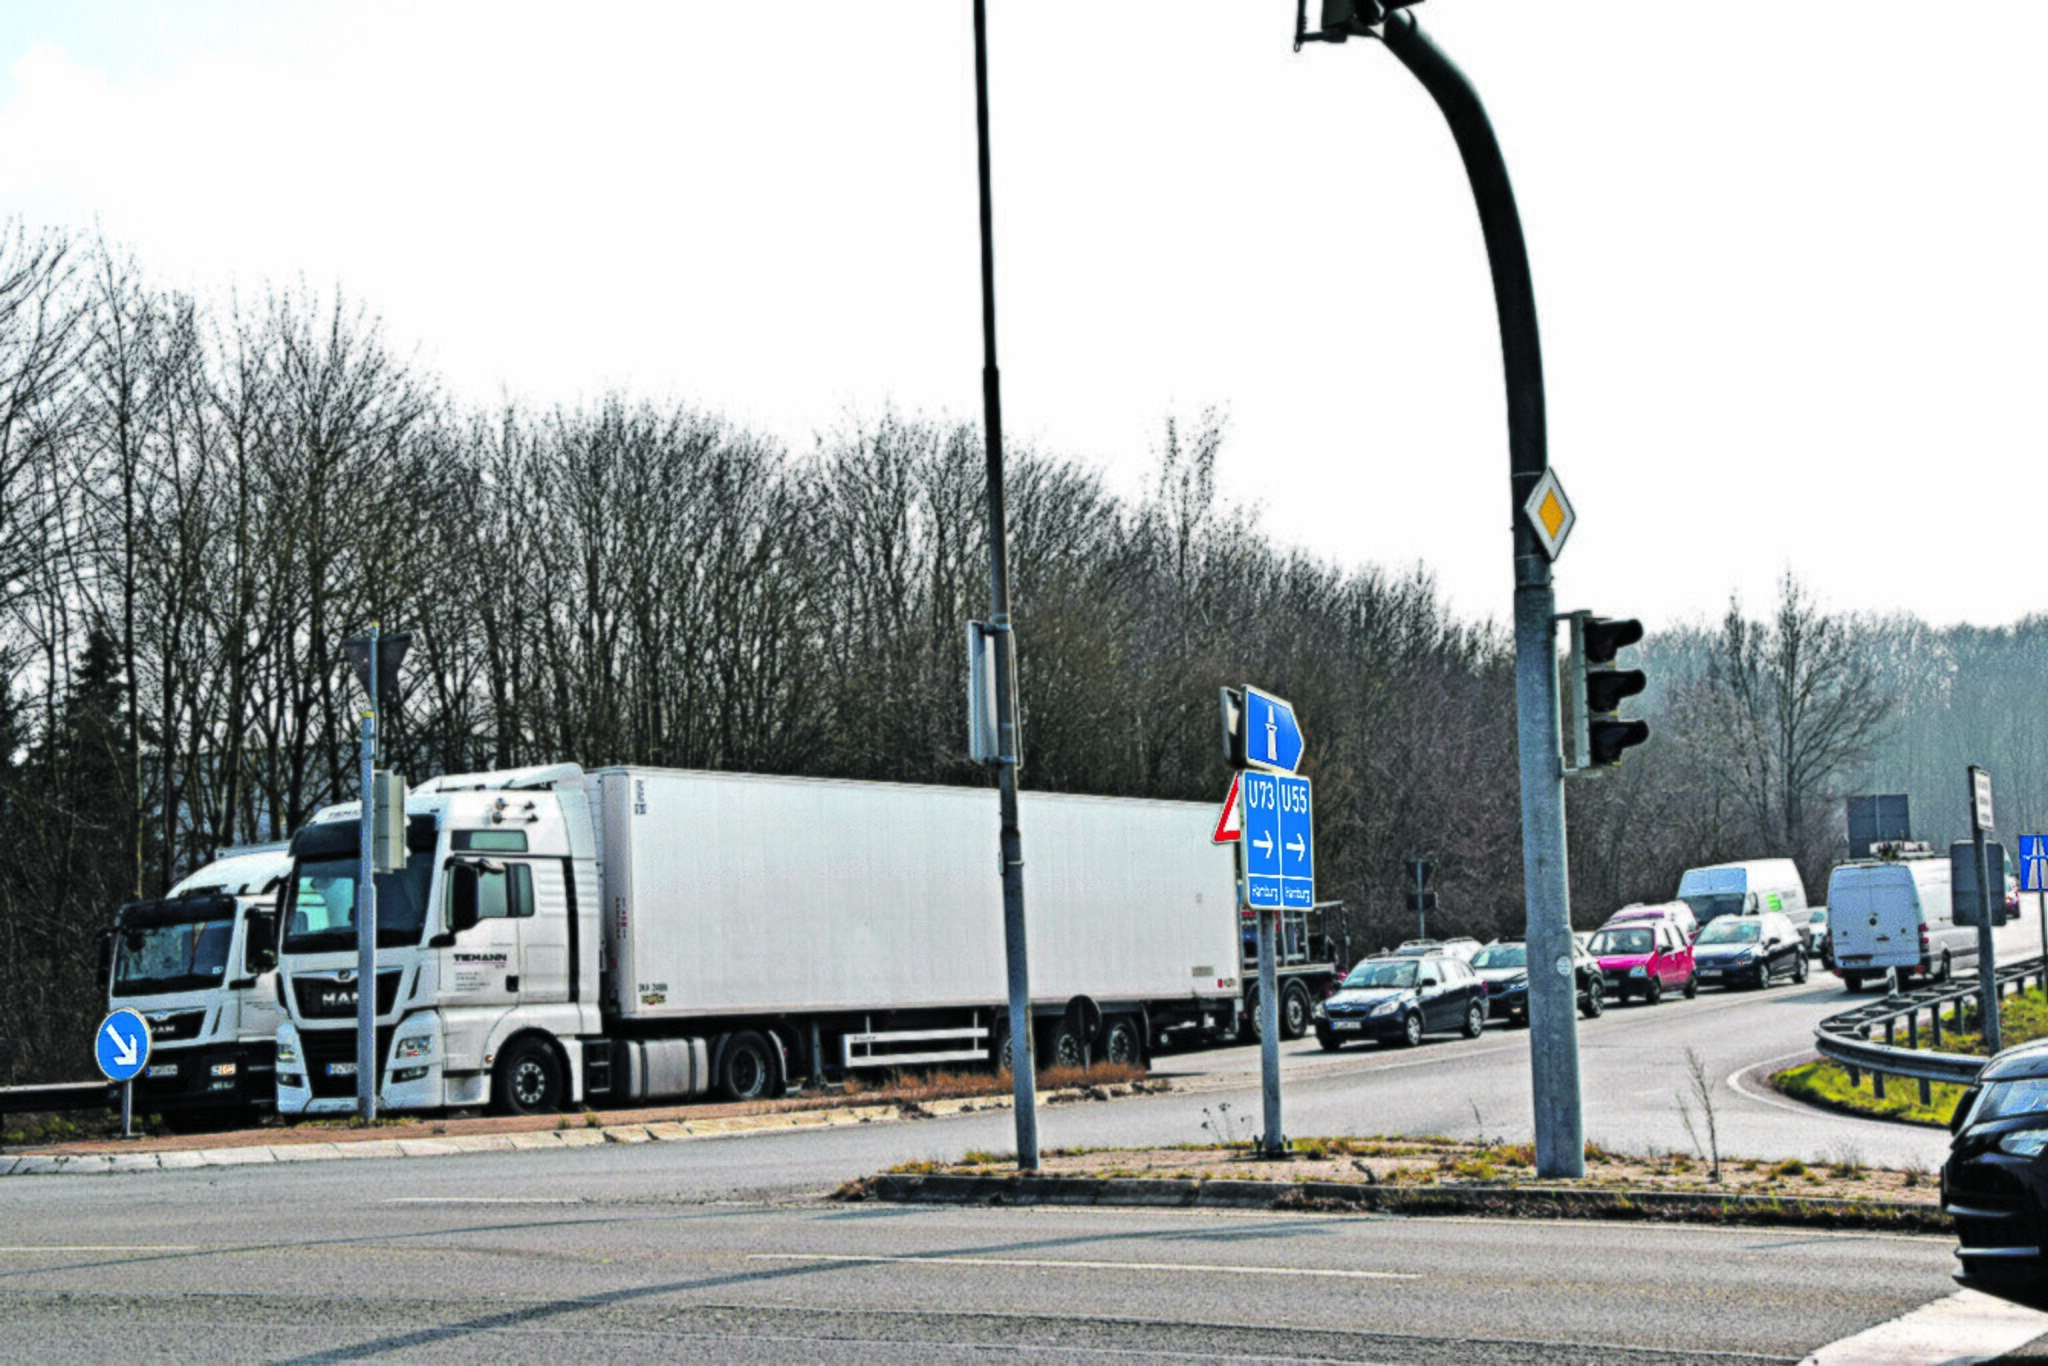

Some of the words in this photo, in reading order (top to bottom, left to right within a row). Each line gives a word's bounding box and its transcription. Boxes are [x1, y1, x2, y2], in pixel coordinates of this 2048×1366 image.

[1248, 779, 1275, 810] U73
[1281, 783, 1308, 815] U55
[1252, 884, 1278, 902] Hamburg
[1285, 886, 1310, 904] Hamburg
[453, 953, 507, 962] TIEMANN
